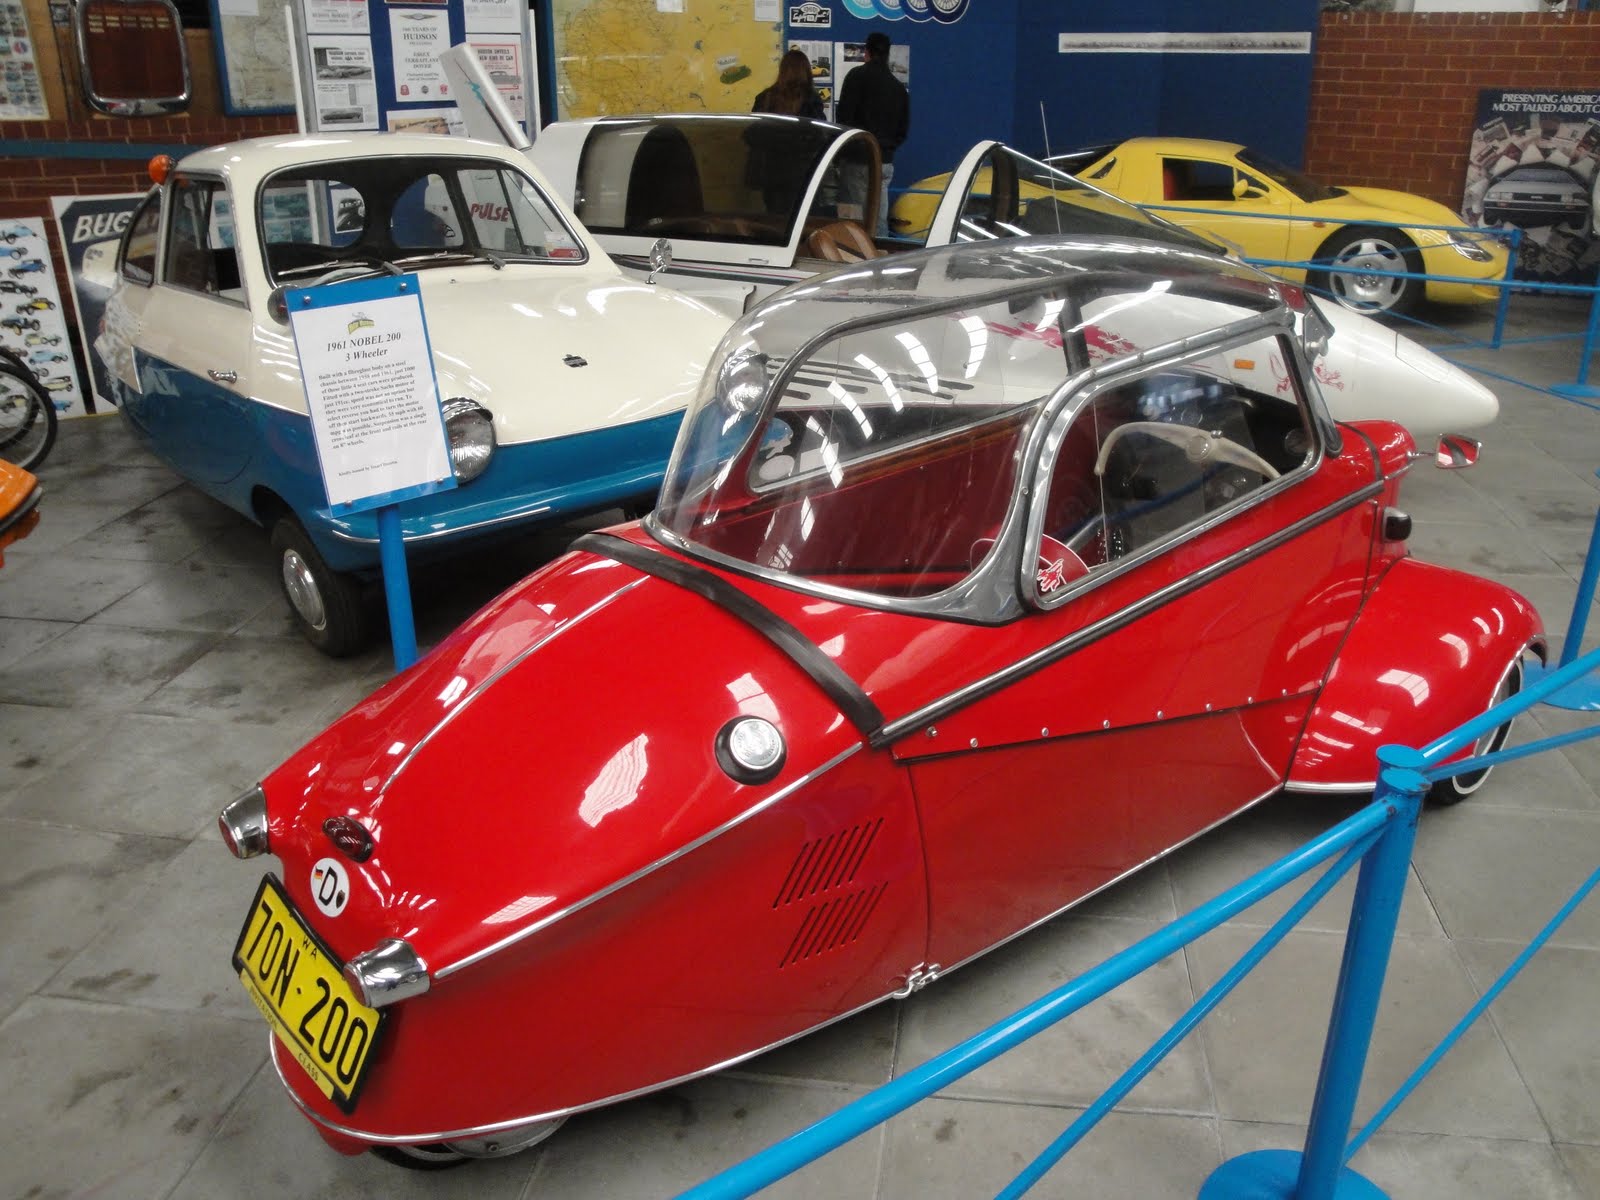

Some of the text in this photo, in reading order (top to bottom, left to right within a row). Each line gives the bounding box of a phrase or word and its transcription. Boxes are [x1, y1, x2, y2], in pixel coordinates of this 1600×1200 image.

[1492, 102, 1521, 112] MOST
[1522, 102, 1557, 112] TALKED
[1557, 104, 1593, 113] ABOUT
[1502, 93, 1558, 103] PRESENTING
[471, 203, 510, 222] PULSE
[327, 332, 400, 351] 1961 NOBEL 200
[345, 348, 387, 361] 3 Wheeler
[319, 866, 338, 906] D
[299, 1052, 319, 1081] CLASS
